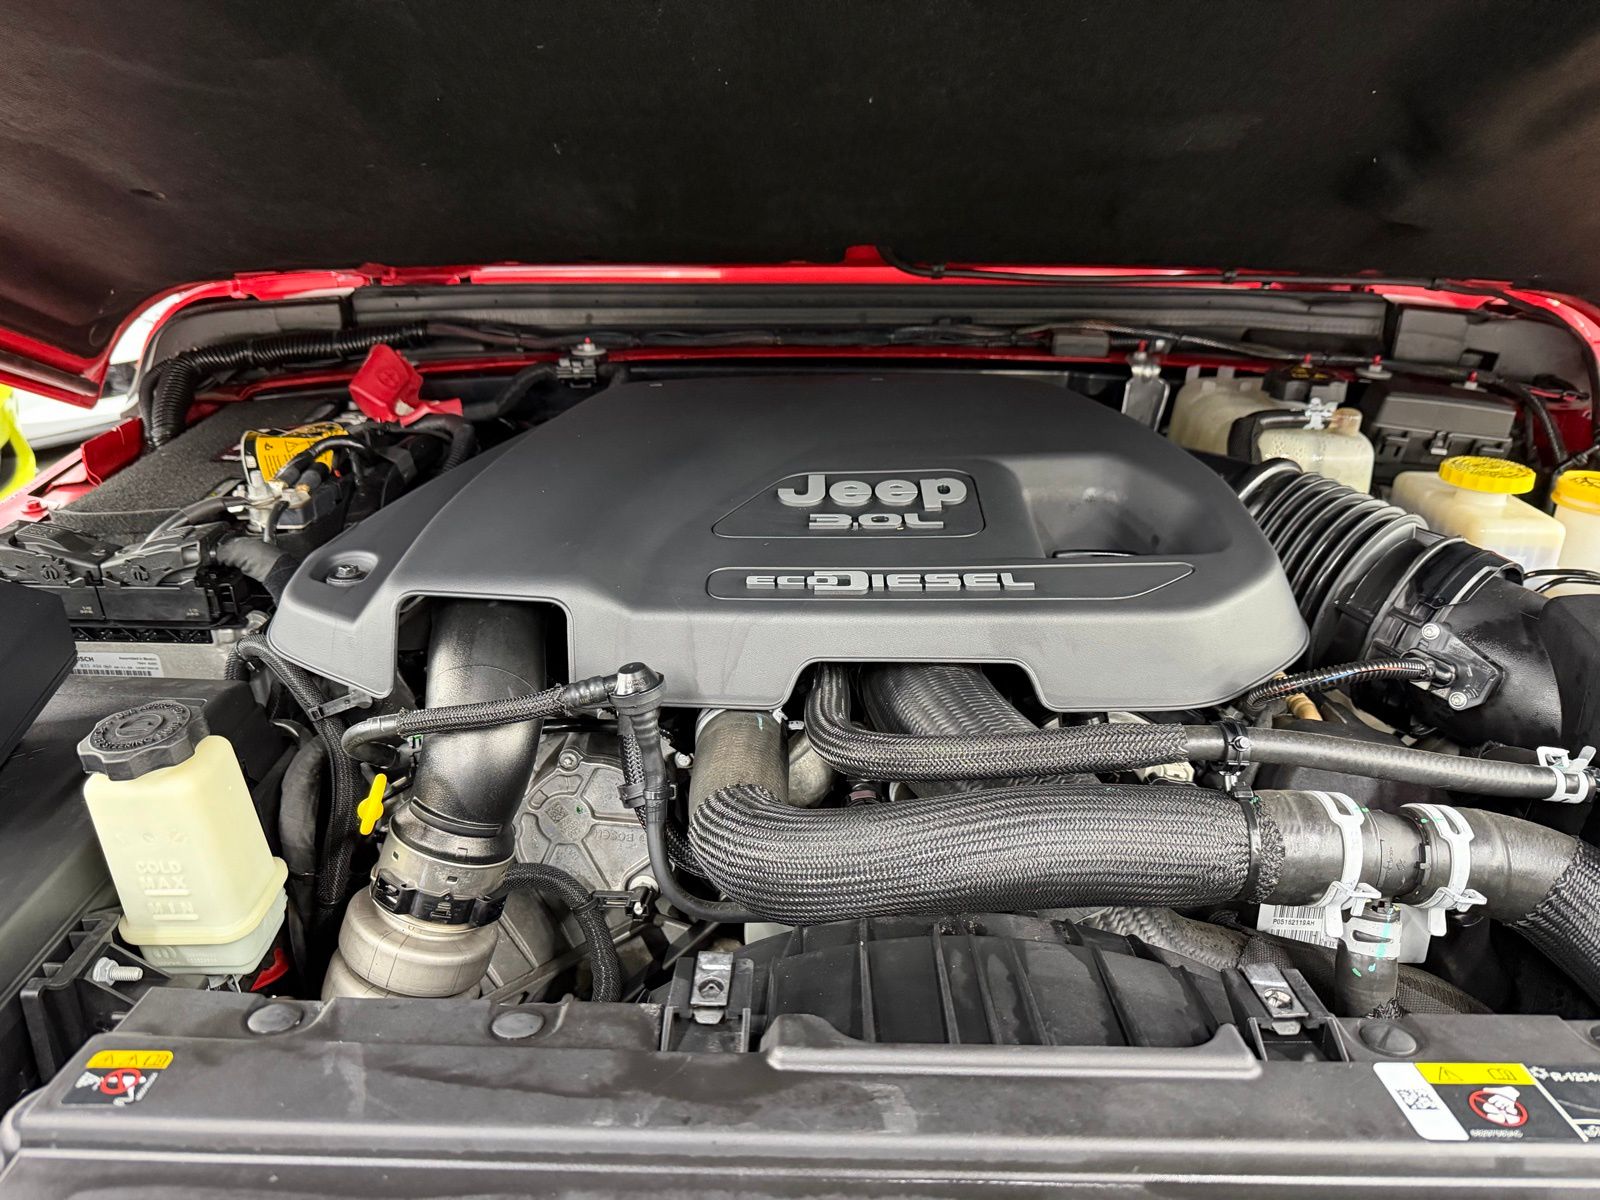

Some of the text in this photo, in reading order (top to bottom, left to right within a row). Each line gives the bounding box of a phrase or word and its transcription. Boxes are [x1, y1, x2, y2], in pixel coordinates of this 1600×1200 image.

[777, 474, 968, 512] Jeep
[808, 512, 945, 531] 3.0L
[135, 859, 183, 874] COLD
[137, 874, 188, 890] MAX
[147, 901, 195, 915] MIN
